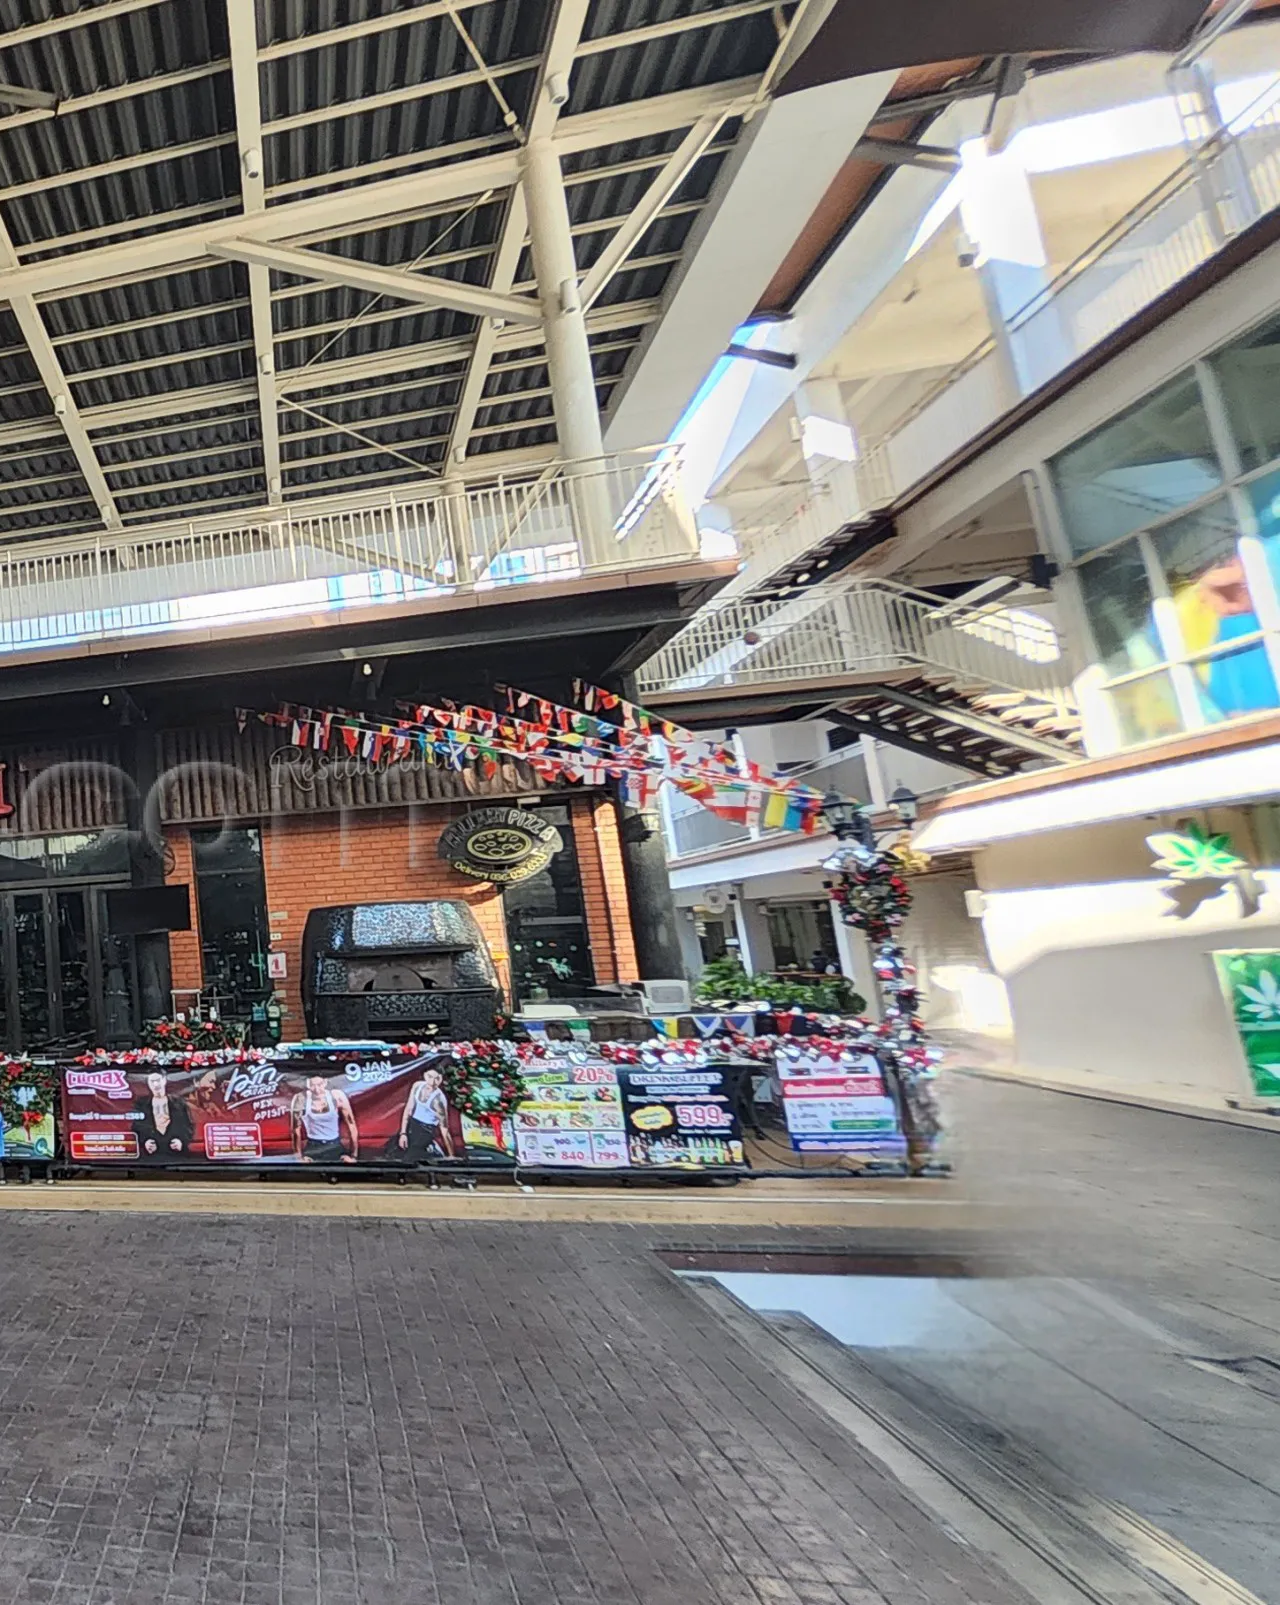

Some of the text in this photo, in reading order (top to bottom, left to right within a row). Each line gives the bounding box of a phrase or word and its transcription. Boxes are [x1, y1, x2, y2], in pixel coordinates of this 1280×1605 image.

[507, 809, 556, 841] PIZZA
[345, 1061, 392, 1082] 9 JAN
[363, 1071, 392, 1082] 2026
[574, 1067, 614, 1083] 20%
